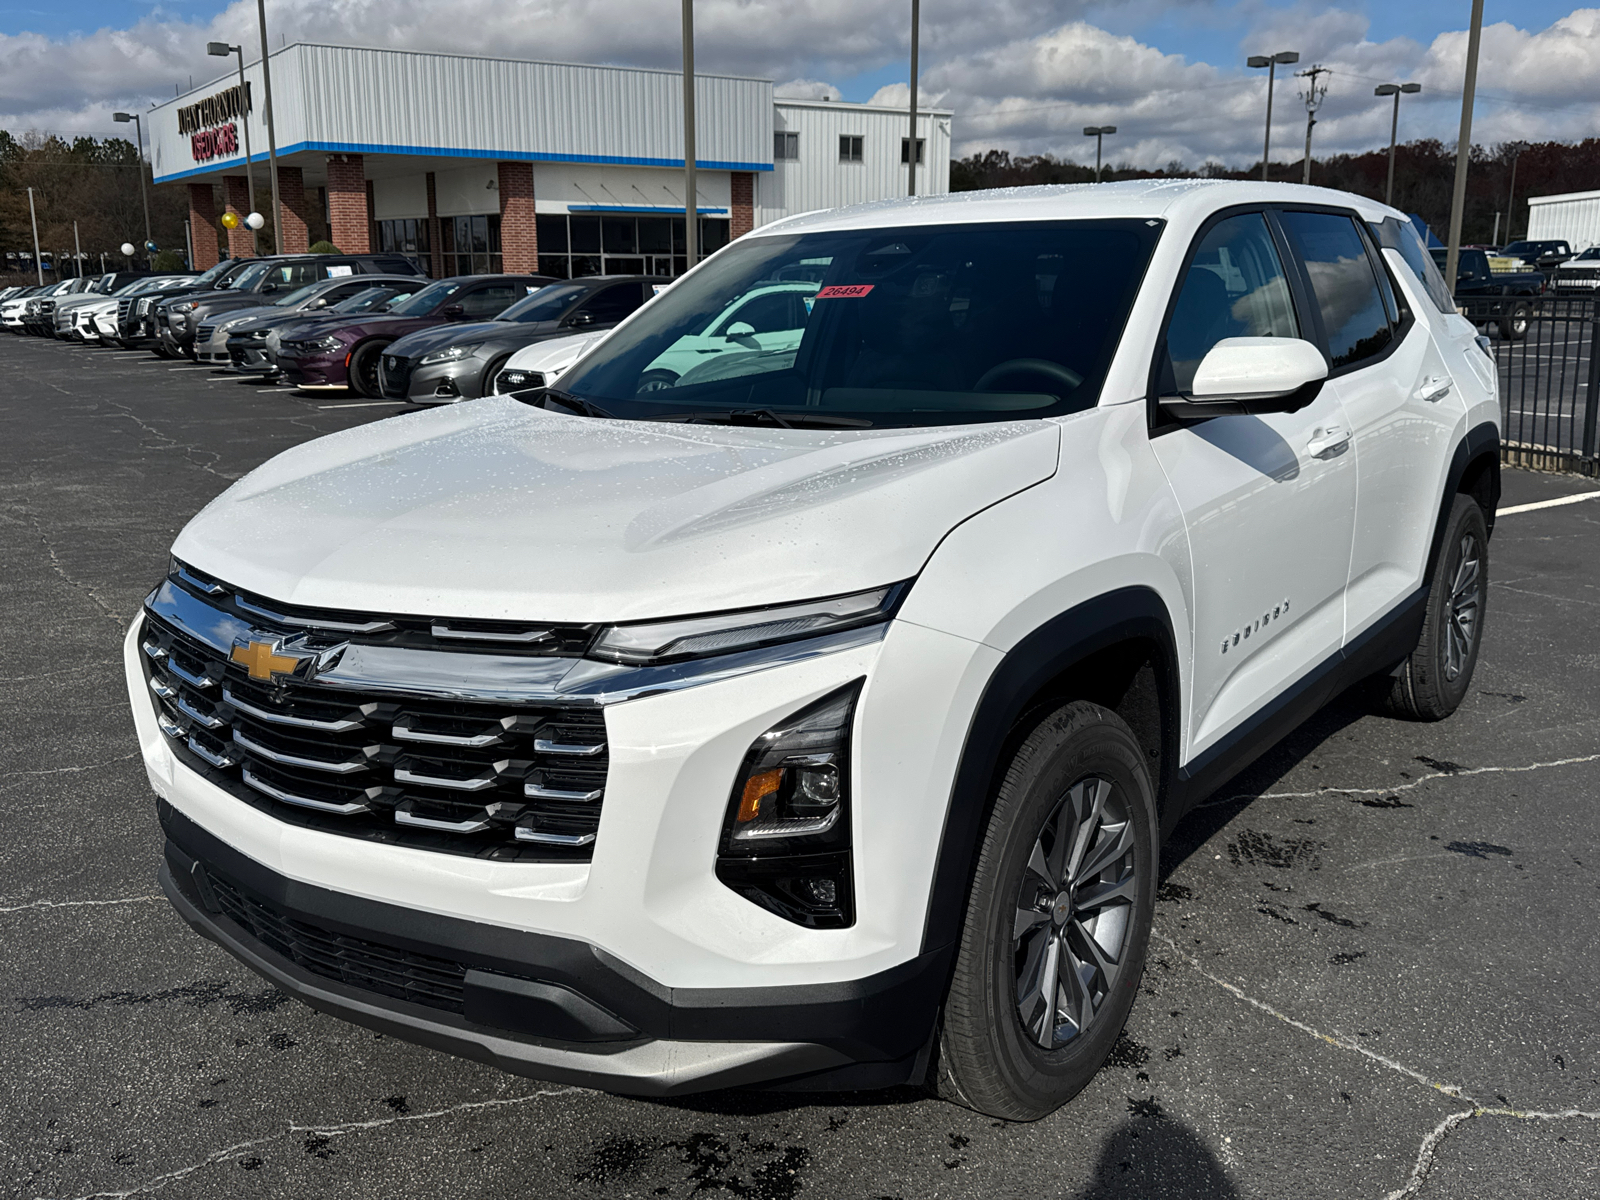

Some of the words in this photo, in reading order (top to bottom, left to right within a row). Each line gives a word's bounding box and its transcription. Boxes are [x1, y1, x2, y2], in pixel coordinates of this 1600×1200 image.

[177, 103, 201, 135] JOHN
[198, 81, 252, 127] THORNTON
[191, 131, 212, 161] USED
[212, 122, 236, 156] CARS
[824, 286, 866, 296] 26494
[1220, 599, 1289, 654] EQUINOX
